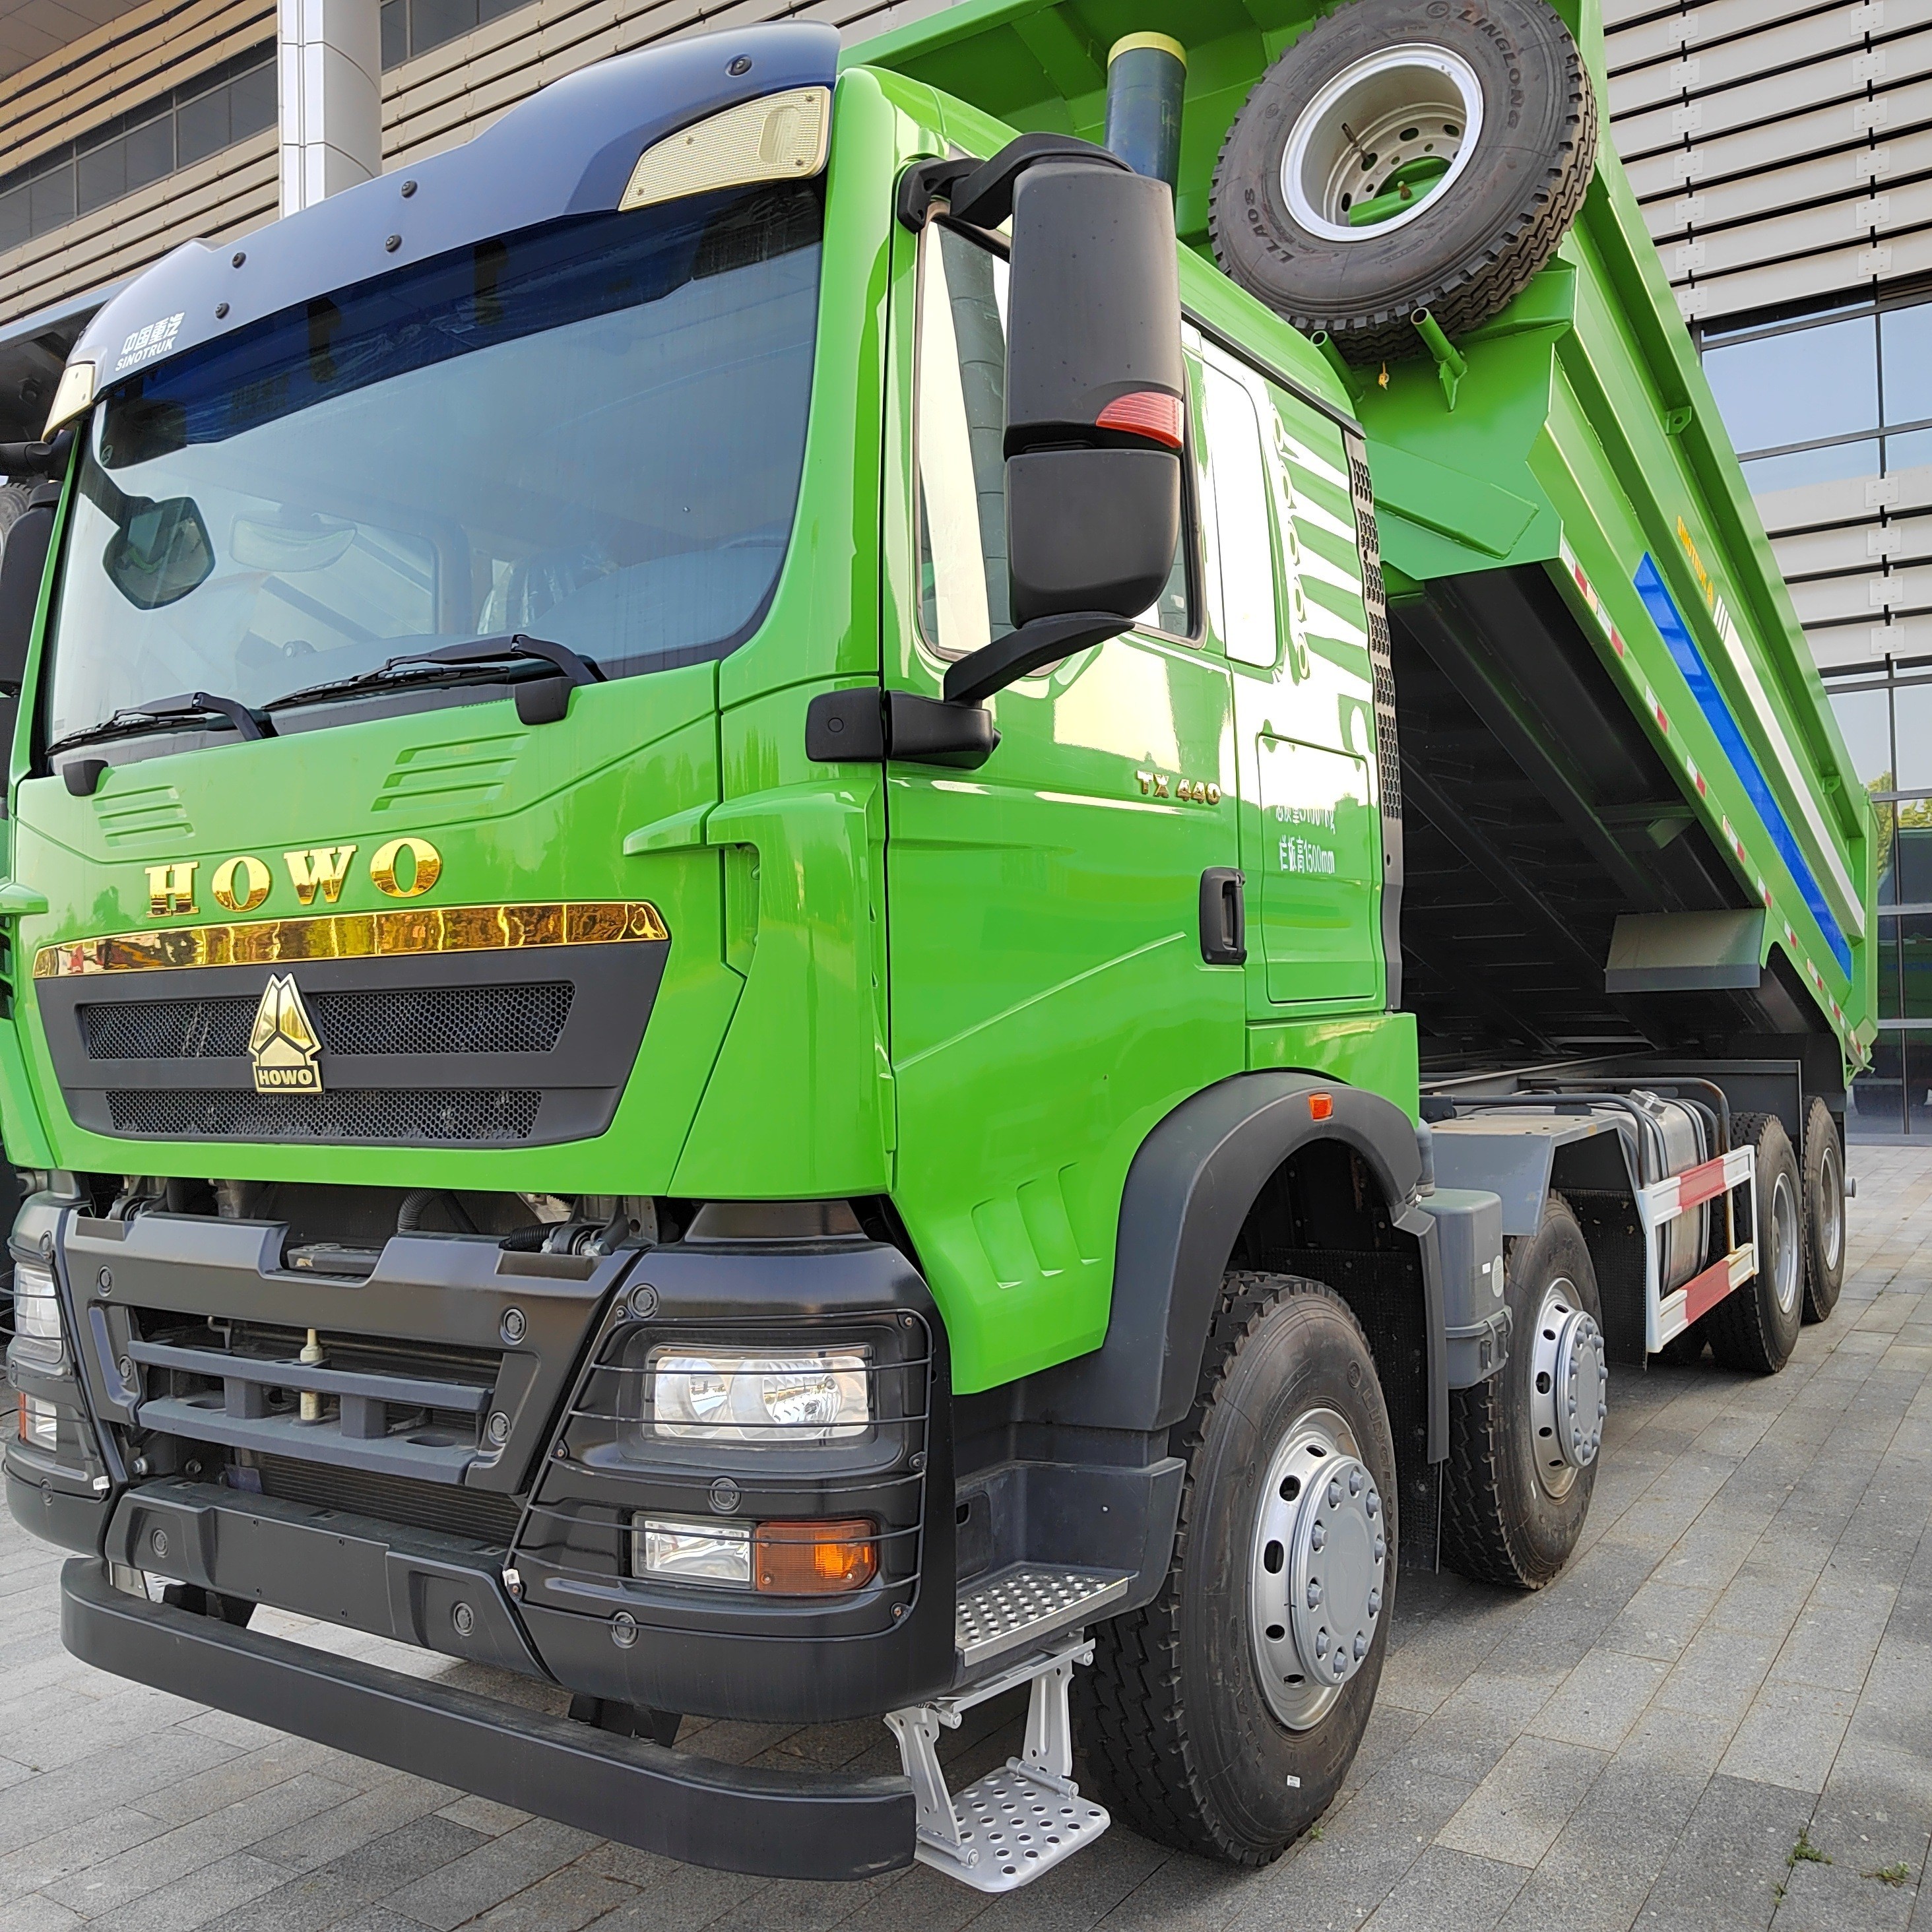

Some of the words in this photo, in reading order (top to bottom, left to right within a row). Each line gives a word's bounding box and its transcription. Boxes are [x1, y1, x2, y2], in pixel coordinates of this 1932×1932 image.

[1456, 9, 1525, 130] LINGLONG
[115, 336, 176, 371] SINOTRUK
[121, 311, 185, 356] 中国重汽
[1136, 769, 1169, 798] TX
[1176, 779, 1221, 805] 440
[1279, 834, 1336, 874] 栏板高1500mm
[145, 837, 441, 918] HOWO
[257, 1068, 313, 1085] HOWO
[1361, 1386, 1395, 1588] LINGLONG
